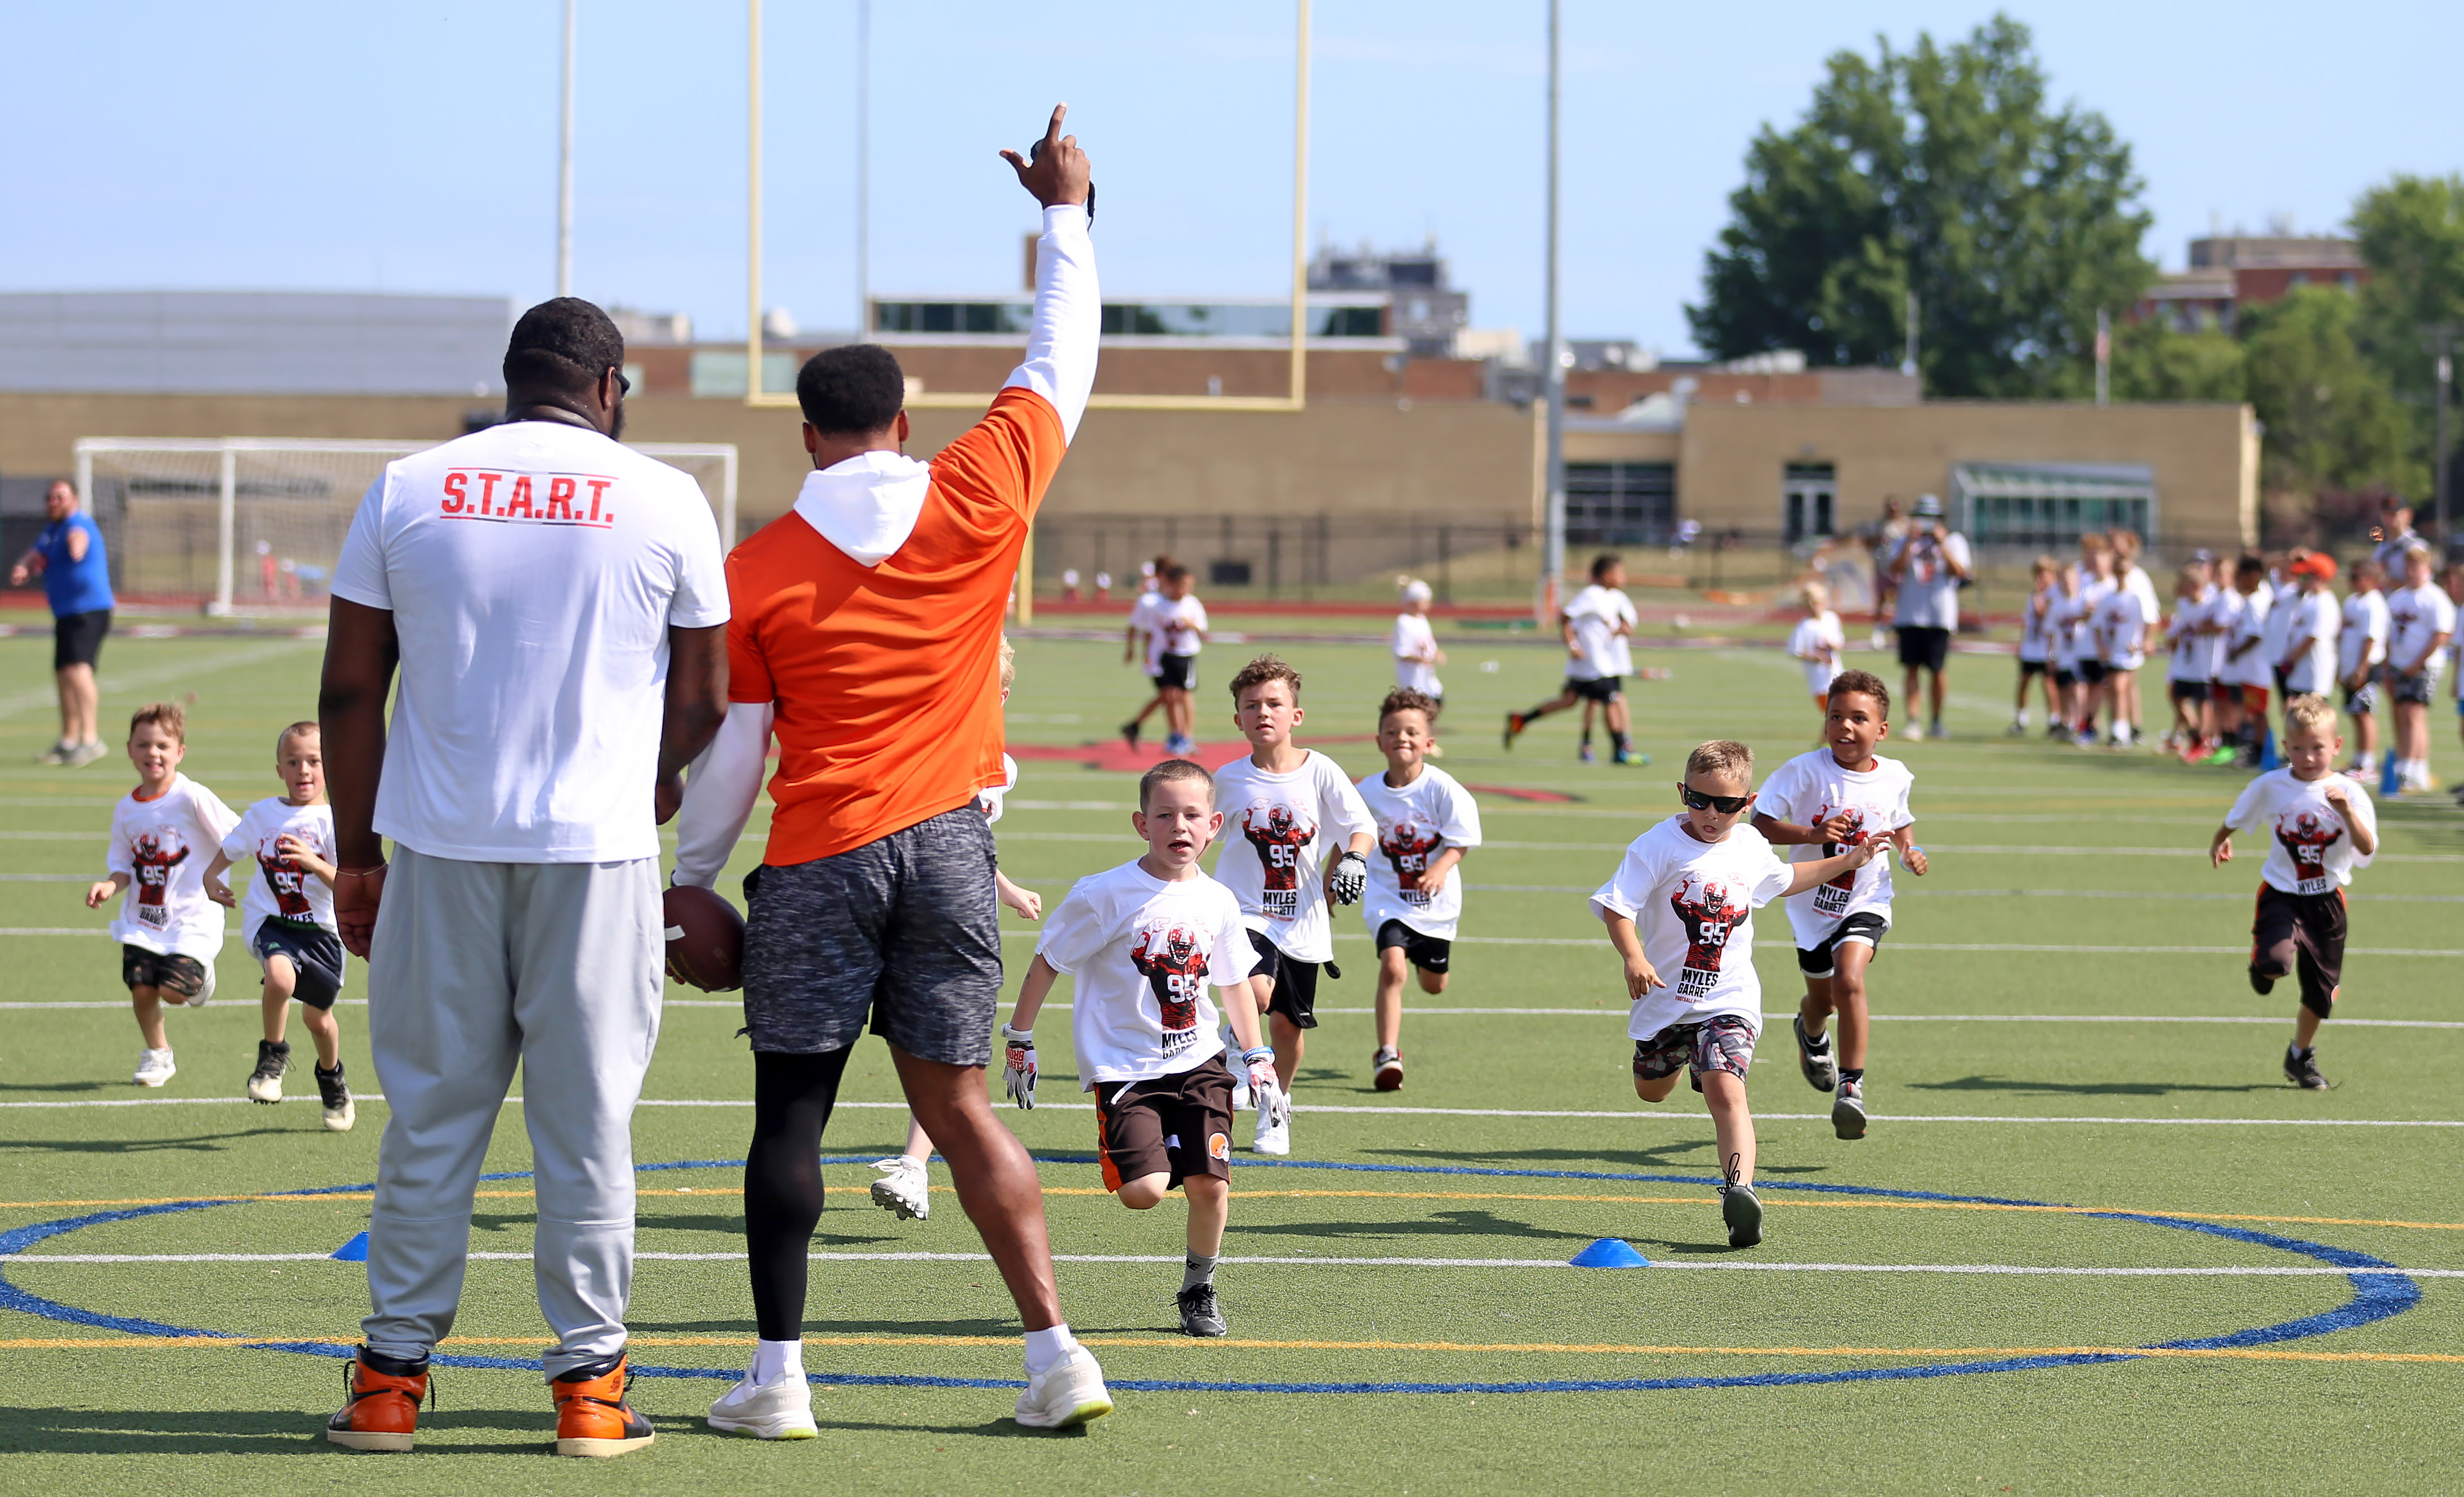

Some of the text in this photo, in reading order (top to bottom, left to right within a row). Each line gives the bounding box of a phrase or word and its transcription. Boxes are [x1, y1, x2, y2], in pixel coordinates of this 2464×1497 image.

[441, 472, 614, 522] S.T.A.R.T.
[1269, 844, 1295, 868] 95
[1399, 853, 1425, 873] 95
[2297, 844, 2321, 864] 95
[142, 865, 166, 886] 95
[275, 872, 300, 894] 95
[2298, 878, 2327, 893] MYLES
[1263, 891, 1297, 905] MYLES
[1818, 884, 1850, 902] MYLES
[1699, 922, 1729, 946] 95
[1681, 968, 1718, 986] MYLES
[1167, 974, 1198, 1003] 95
[1677, 982, 1710, 998] GARRET
